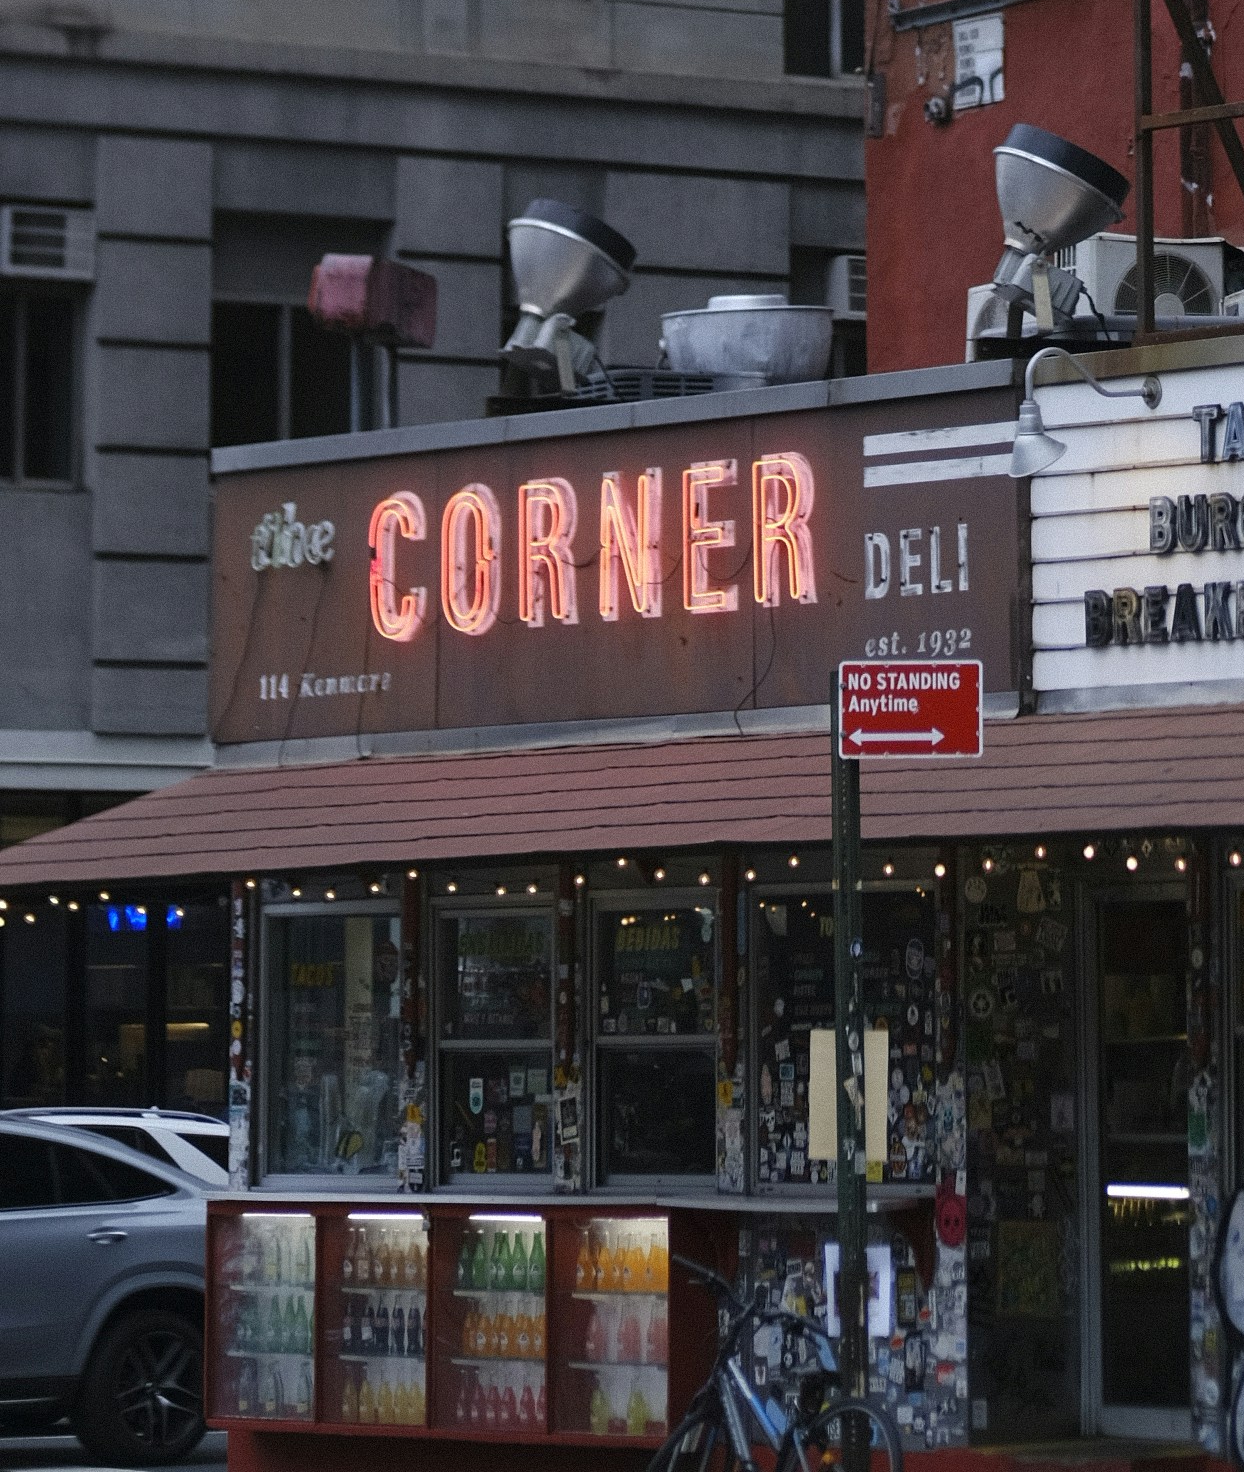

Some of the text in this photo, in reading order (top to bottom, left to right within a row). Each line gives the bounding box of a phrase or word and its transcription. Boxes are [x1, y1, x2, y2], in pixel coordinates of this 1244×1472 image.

[368, 450, 819, 644] CORNER
[863, 522, 970, 601] DELI
[864, 627, 973, 658] est. 1932
[259, 672, 290, 701] 114
[847, 671, 961, 691] NO STANDING
[848, 694, 919, 717] Anytime
